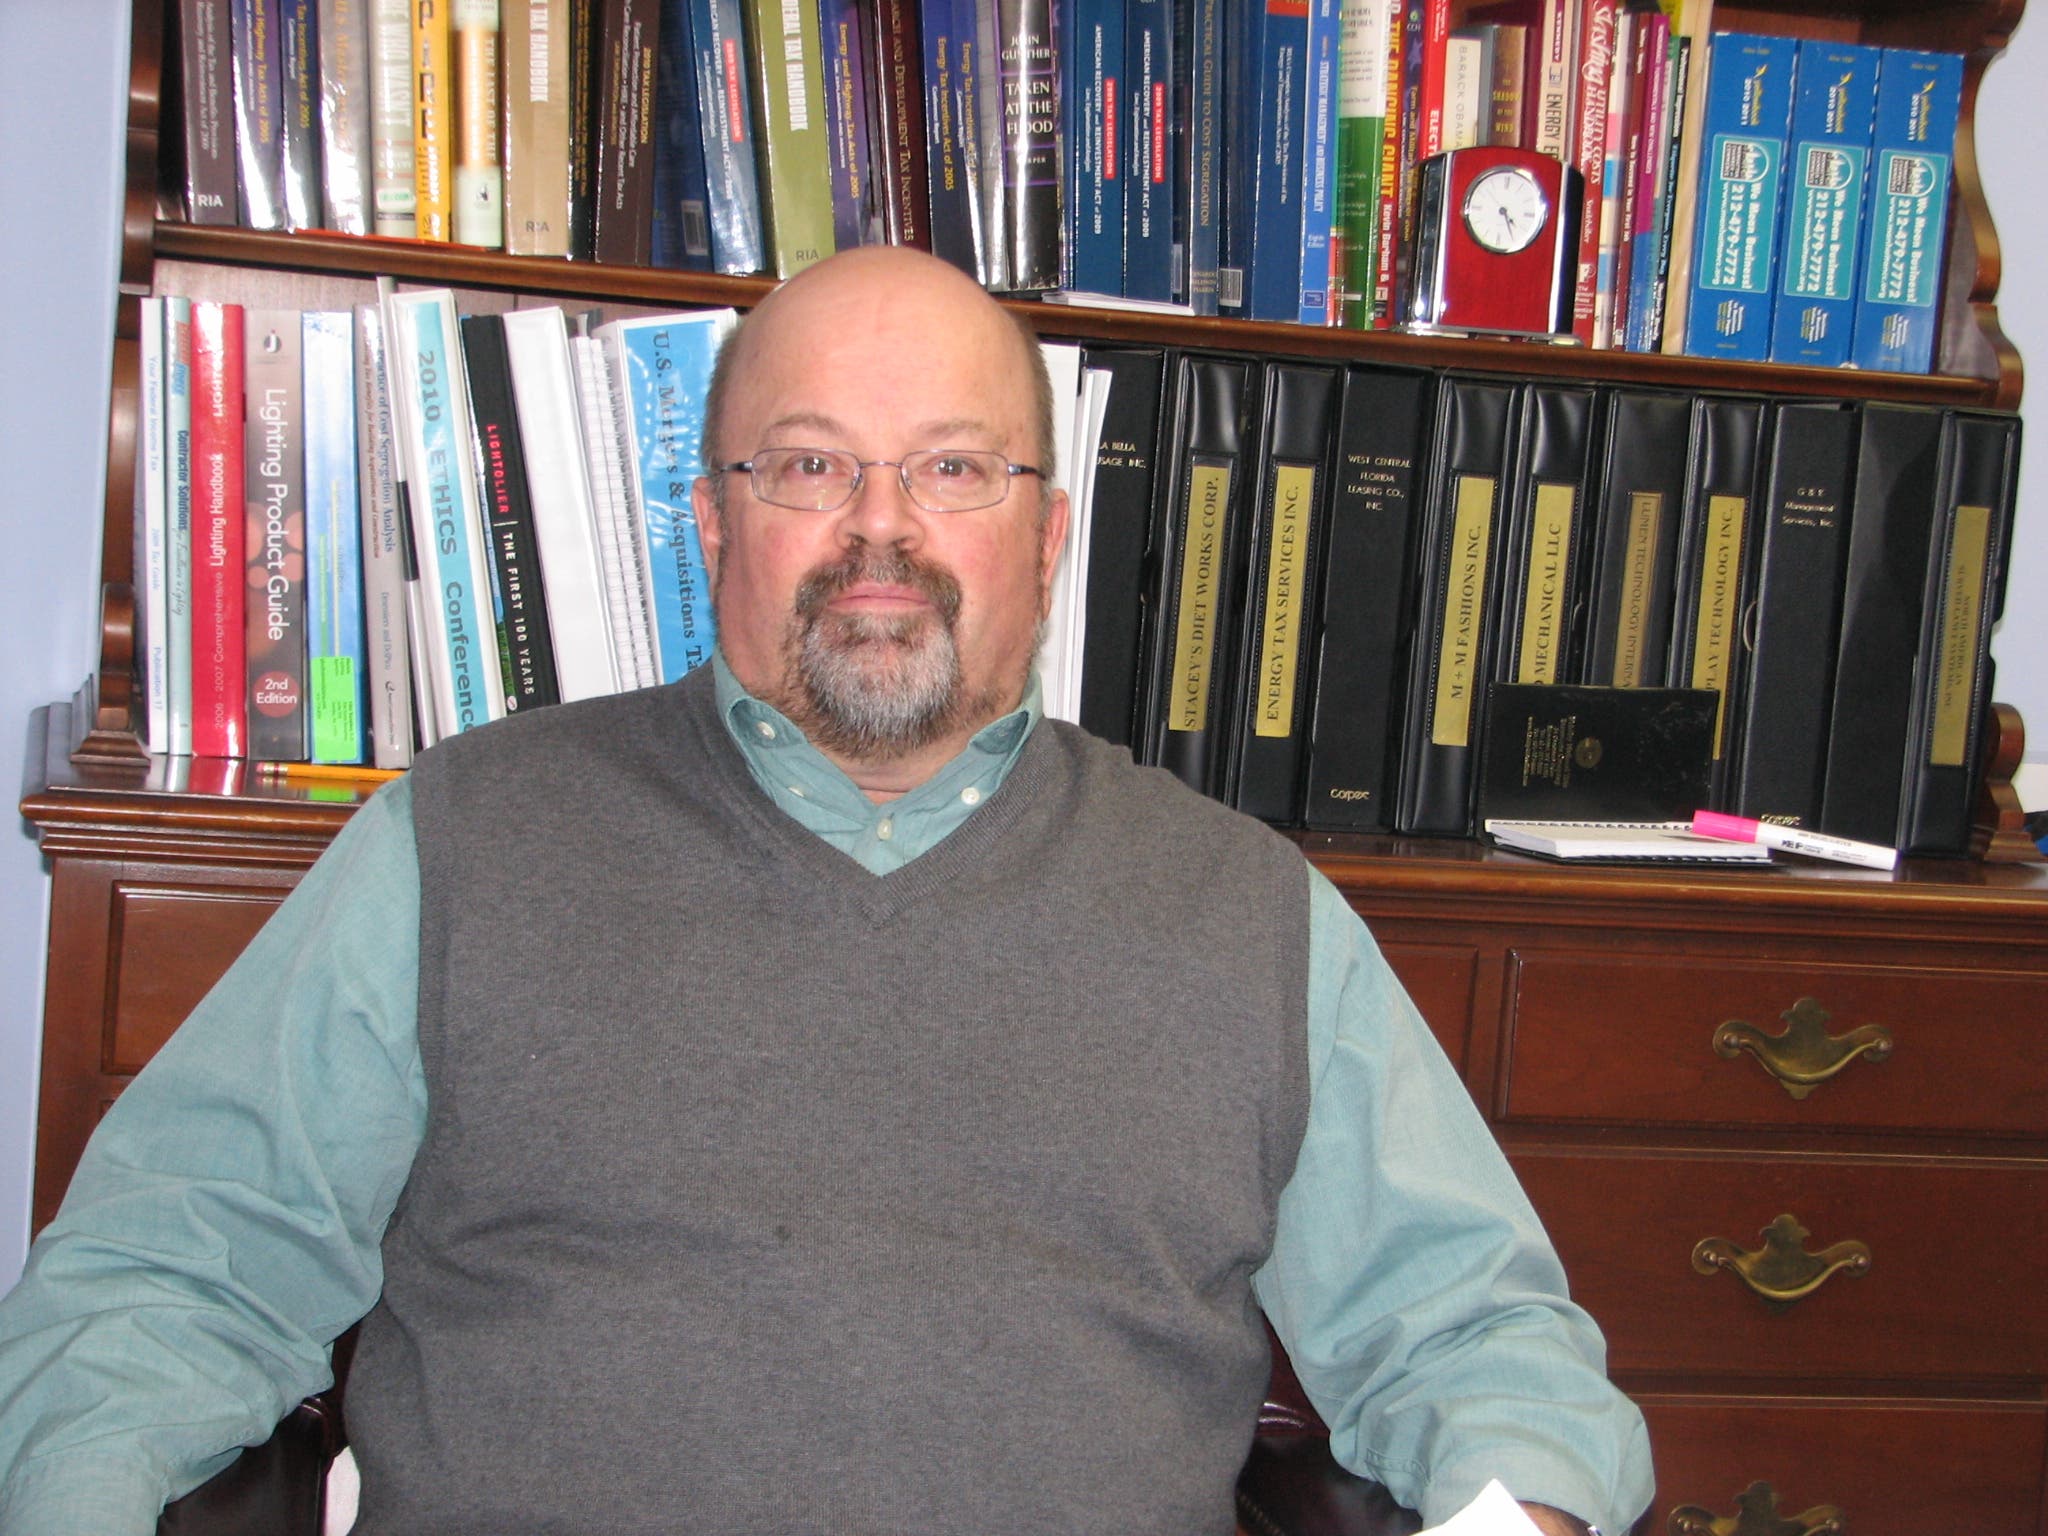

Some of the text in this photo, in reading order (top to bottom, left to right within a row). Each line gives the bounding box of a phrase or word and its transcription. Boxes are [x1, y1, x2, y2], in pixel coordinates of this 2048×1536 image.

[298, 5, 308, 89] Tax Incentives Act
[530, 8, 549, 102] TAX HANDBOOK
[784, 39, 802, 61] TAX
[1553, 11, 1563, 61] KENNEDY
[1581, 2, 1614, 85] Slashing
[786, 63, 808, 131] HANDBOOK
[837, 23, 860, 198] Energy and Highway Tax Acts 2005
[937, 38, 955, 191] Energy Tax Incentives Act of 2005
[1094, 26, 1103, 234] AMERICAN RECOVERY REINVESTMENT ACT 2009
[1384, 60, 1400, 138] DANCING
[1454, 46, 1468, 149] BARACK OBAMA
[1545, 93, 1563, 140] ENERGY
[1740, 79, 1752, 126] 2010 2011
[1824, 86, 1836, 134] 2010 2011
[1908, 94, 1920, 142] 2010 2011
[1106, 104, 1115, 175] TAX LEGISLATION
[1142, 31, 1151, 238] AMERICAN RECOVERY REINVESTMENT ACT 2009
[1154, 108, 1162, 179] TAX LEGISLATION
[1201, 118, 1213, 147] COST
[1590, 88, 1607, 184] UTILITY COSTS
[198, 195, 224, 207] RIA
[1199, 151, 1212, 227] SEGREGATION
[1381, 145, 1396, 198] GIANT
[1625, 198, 1635, 212] Your
[1627, 160, 1637, 187] Succeed
[1382, 204, 1393, 231] Kevin
[1624, 214, 1634, 230] First
[1722, 183, 1745, 285] 212-479-7772
[1740, 182, 1762, 289] We Mean Business!
[1807, 191, 1830, 292] 212-479-7772
[1823, 190, 1845, 297] We Mean Business!
[1890, 199, 1912, 299] 212-479-7772
[1906, 197, 1928, 303] We Mean Business!
[796, 251, 820, 262] RIA
[651, 332, 672, 378] U.S.
[379, 397, 388, 408] of
[379, 411, 390, 435] Cost
[658, 385, 681, 473] Mergers
[177, 430, 190, 530] Contractor Solutions
[377, 437, 394, 504] Segregation
[418, 349, 441, 422] 2010
[430, 449, 458, 556] ETHICS
[485, 424, 510, 513] LIGHTOLIER
[1348, 454, 1412, 468] WEST CENTRAL
[1360, 472, 1395, 483] FLORIDA
[259, 389, 290, 641] Lighting Product Guide
[668, 482, 685, 499] &
[1348, 484, 1383, 496] LEASING
[1636, 501, 1652, 544] LUMEN
[1718, 506, 1735, 539] INC.
[148, 356, 163, 711] Your Federal Income Tax Publication 17
[379, 507, 396, 553] Analysis
[502, 533, 516, 560] THE
[1466, 525, 1481, 559] INC.
[208, 453, 228, 729] 2006 2007 Comprehensive Lighting Handbook
[506, 568, 523, 610] FIRST
[667, 509, 698, 639] Acquisitions
[1184, 477, 1220, 728] STACEY'S DIET WORKS CORP.
[1266, 486, 1300, 721] ENERGY TAX SERVICES INC.
[1457, 564, 1475, 646] FASHIONS
[1535, 523, 1560, 676] MECHANICAL LLC
[1629, 545, 1648, 632] TECHNOLOGY
[1708, 542, 1731, 646] TECHNOLOGY
[514, 617, 527, 642] 100
[1454, 650, 1467, 666] M
[1954, 596, 1971, 686] NORTH AMERICAN
[256, 692, 298, 704] Edition
[264, 678, 289, 691] 2nd
[518, 649, 535, 695] YEARS
[1451, 684, 1464, 699] M
